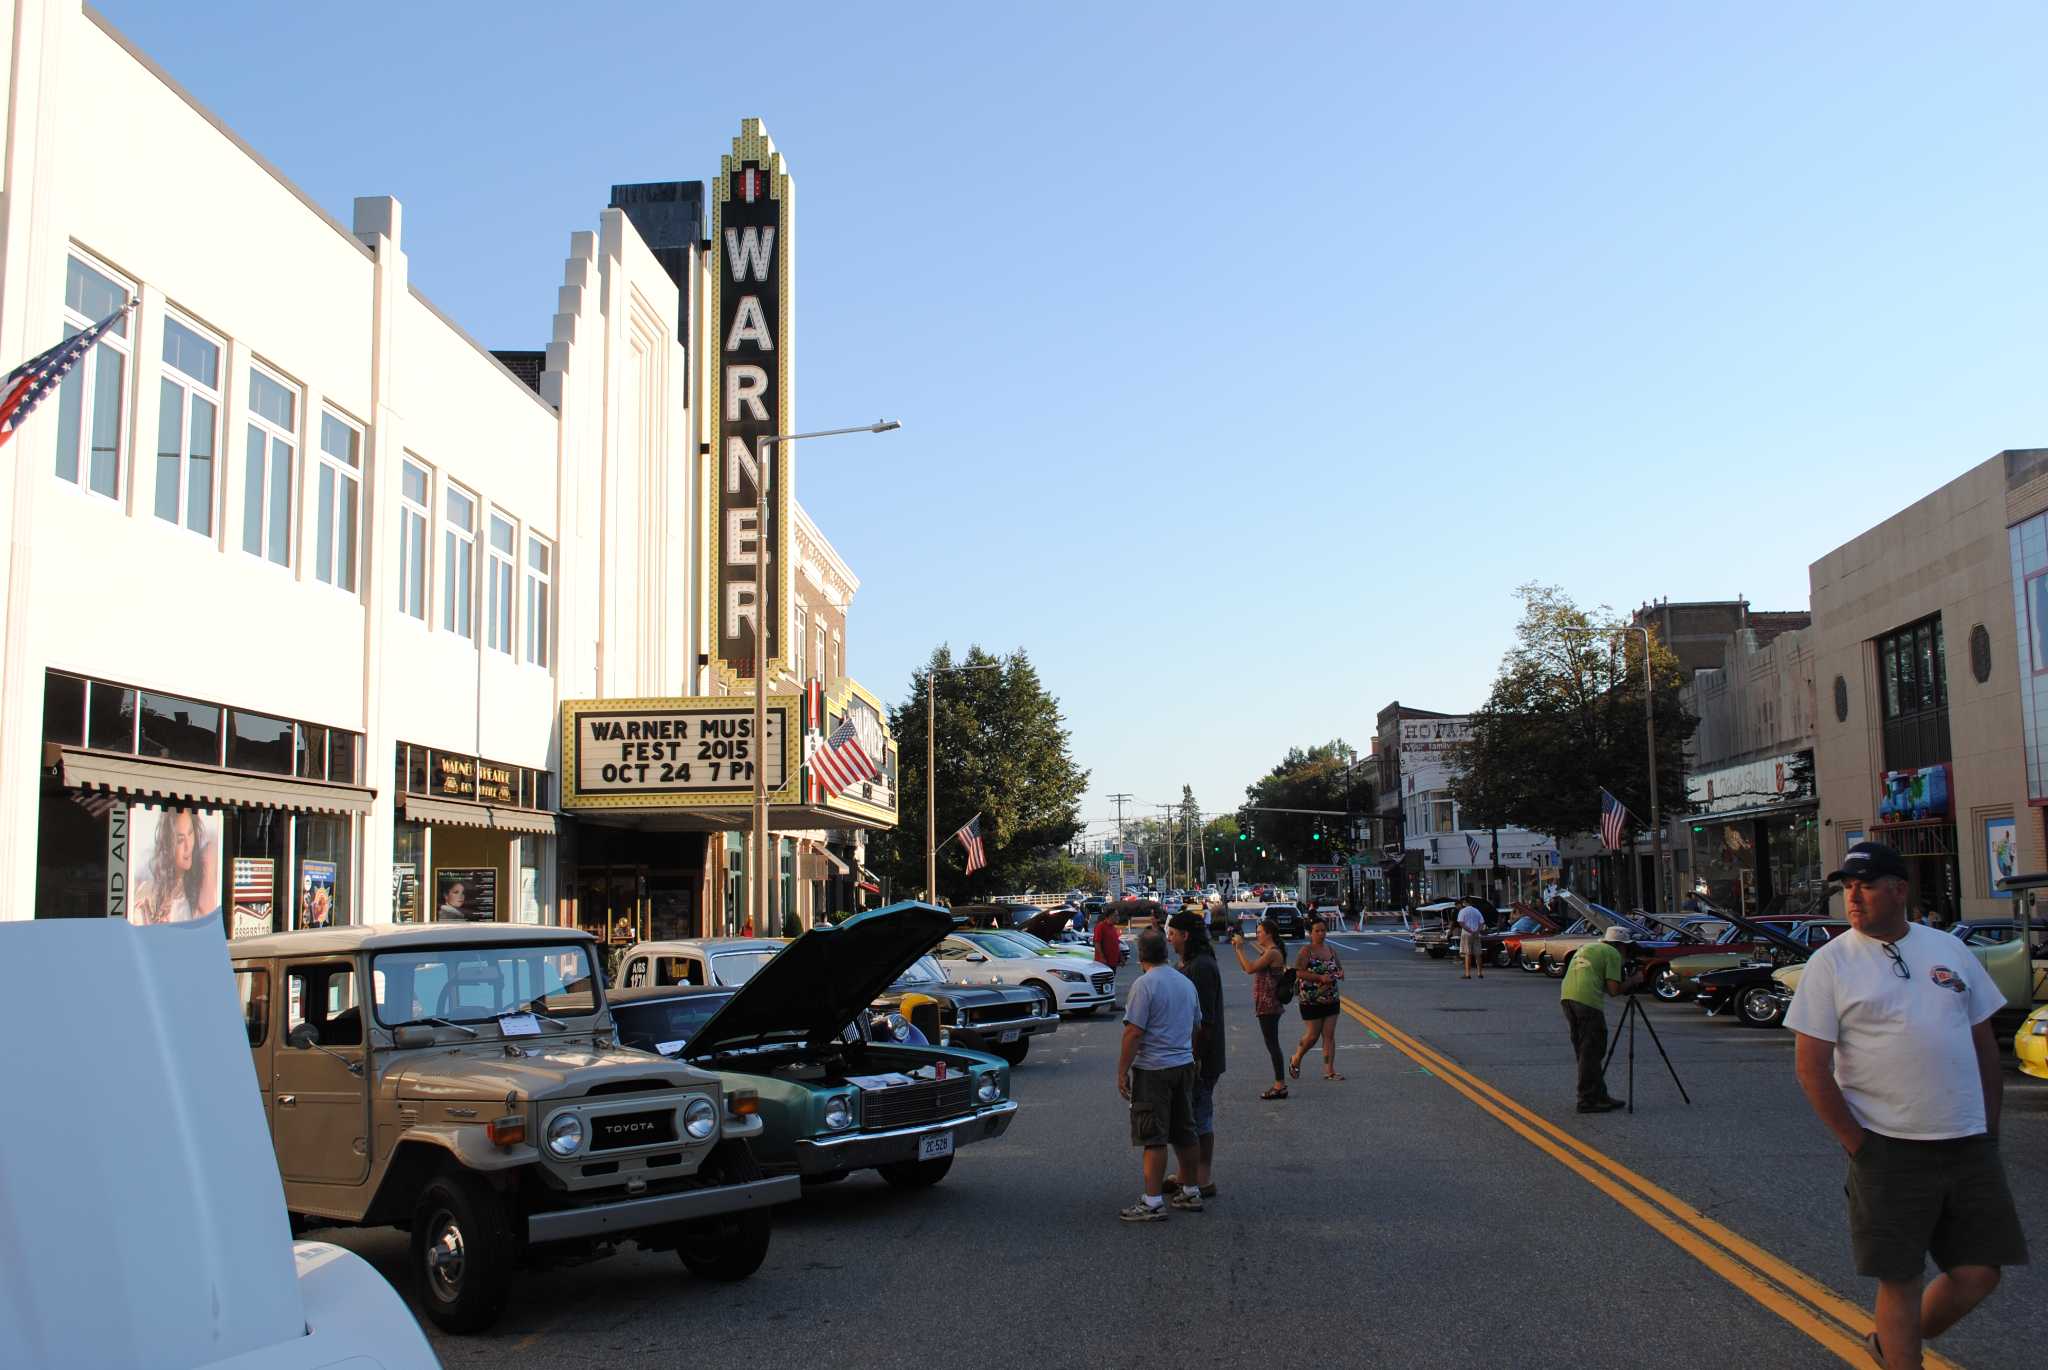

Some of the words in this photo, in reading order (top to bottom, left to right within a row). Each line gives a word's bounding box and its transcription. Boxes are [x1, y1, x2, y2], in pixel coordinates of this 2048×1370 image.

[724, 224, 775, 640] WARNER
[591, 720, 688, 741] WARNER
[1404, 724, 1473, 739] HOWAR
[621, 741, 681, 762] FEST
[697, 740, 749, 761] 2015
[601, 763, 650, 783] OCT
[659, 762, 691, 783] 24
[708, 761, 721, 782] 7
[111, 810, 126, 862] ANI
[110, 872, 124, 916] ND
[605, 1122, 655, 1134] TOYOTA
